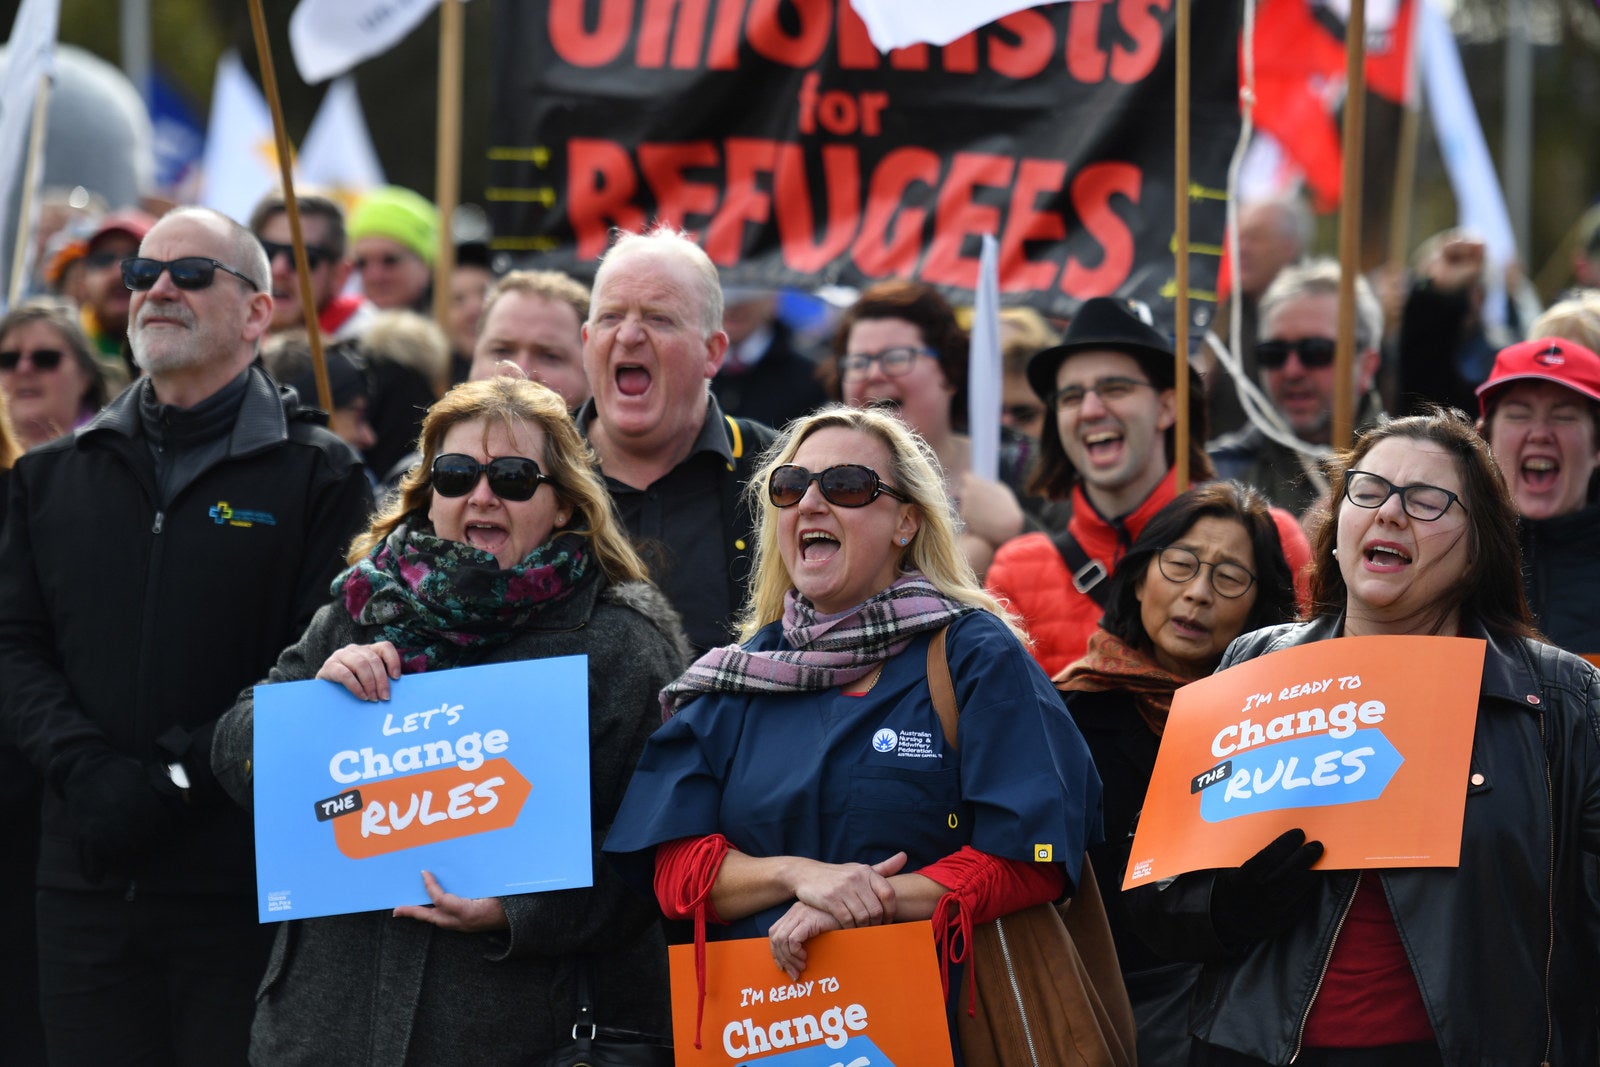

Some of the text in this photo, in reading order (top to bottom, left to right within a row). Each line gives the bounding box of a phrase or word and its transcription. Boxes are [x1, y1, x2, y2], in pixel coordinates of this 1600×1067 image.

[798, 72, 888, 136] for
[566, 136, 1142, 299] REFUGEES
[382, 703, 465, 737] LET'S
[1241, 674, 1362, 713] I'M READY TO
[328, 728, 509, 784] Change
[1211, 699, 1386, 758] Change
[1197, 765, 1227, 788] THE
[1223, 746, 1376, 803] RULES
[321, 794, 356, 816] THE
[360, 776, 505, 839] RULES
[740, 976, 840, 1007] I'M READY TO
[722, 1003, 869, 1059] Change
